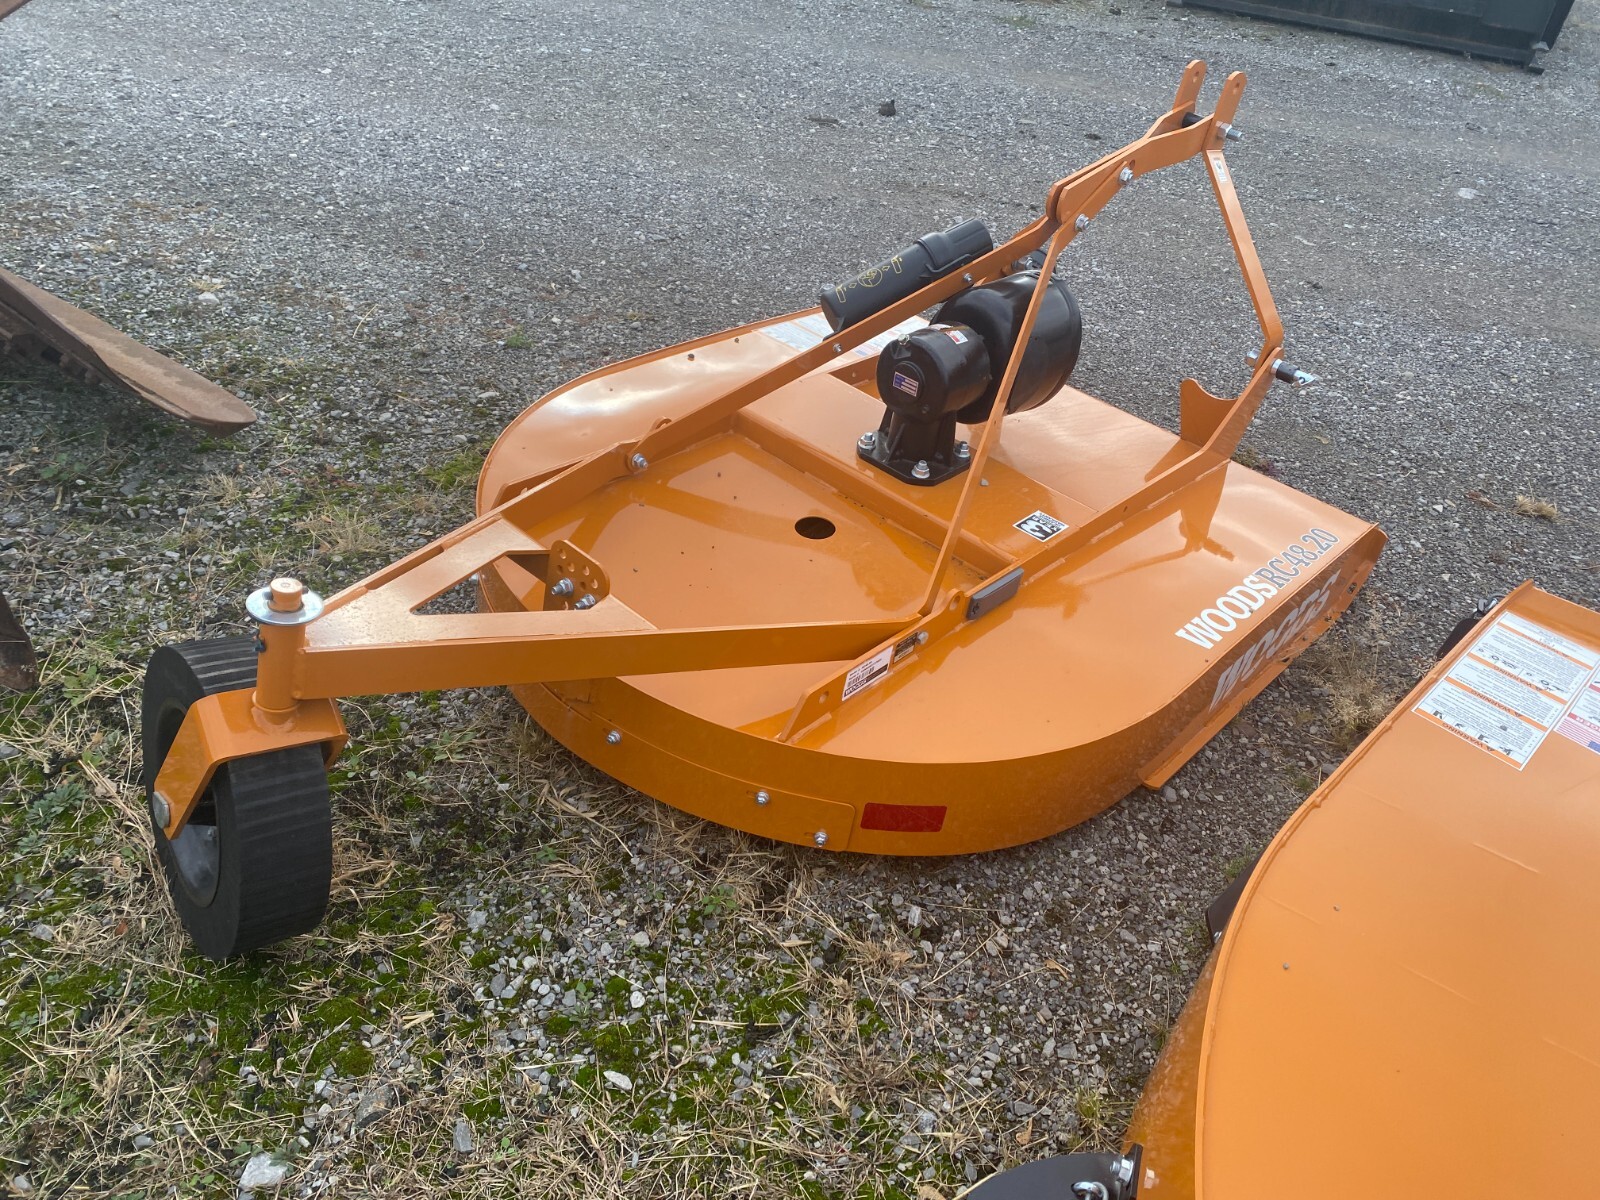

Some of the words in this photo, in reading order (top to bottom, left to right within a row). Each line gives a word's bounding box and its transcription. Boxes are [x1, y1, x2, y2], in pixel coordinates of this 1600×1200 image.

[1020, 519, 1053, 538] 3
[1174, 574, 1278, 650] WOODS
[1493, 665, 1533, 688] WARNING
[1471, 690, 1512, 714] WARNING
[1442, 722, 1484, 749] WARNING
